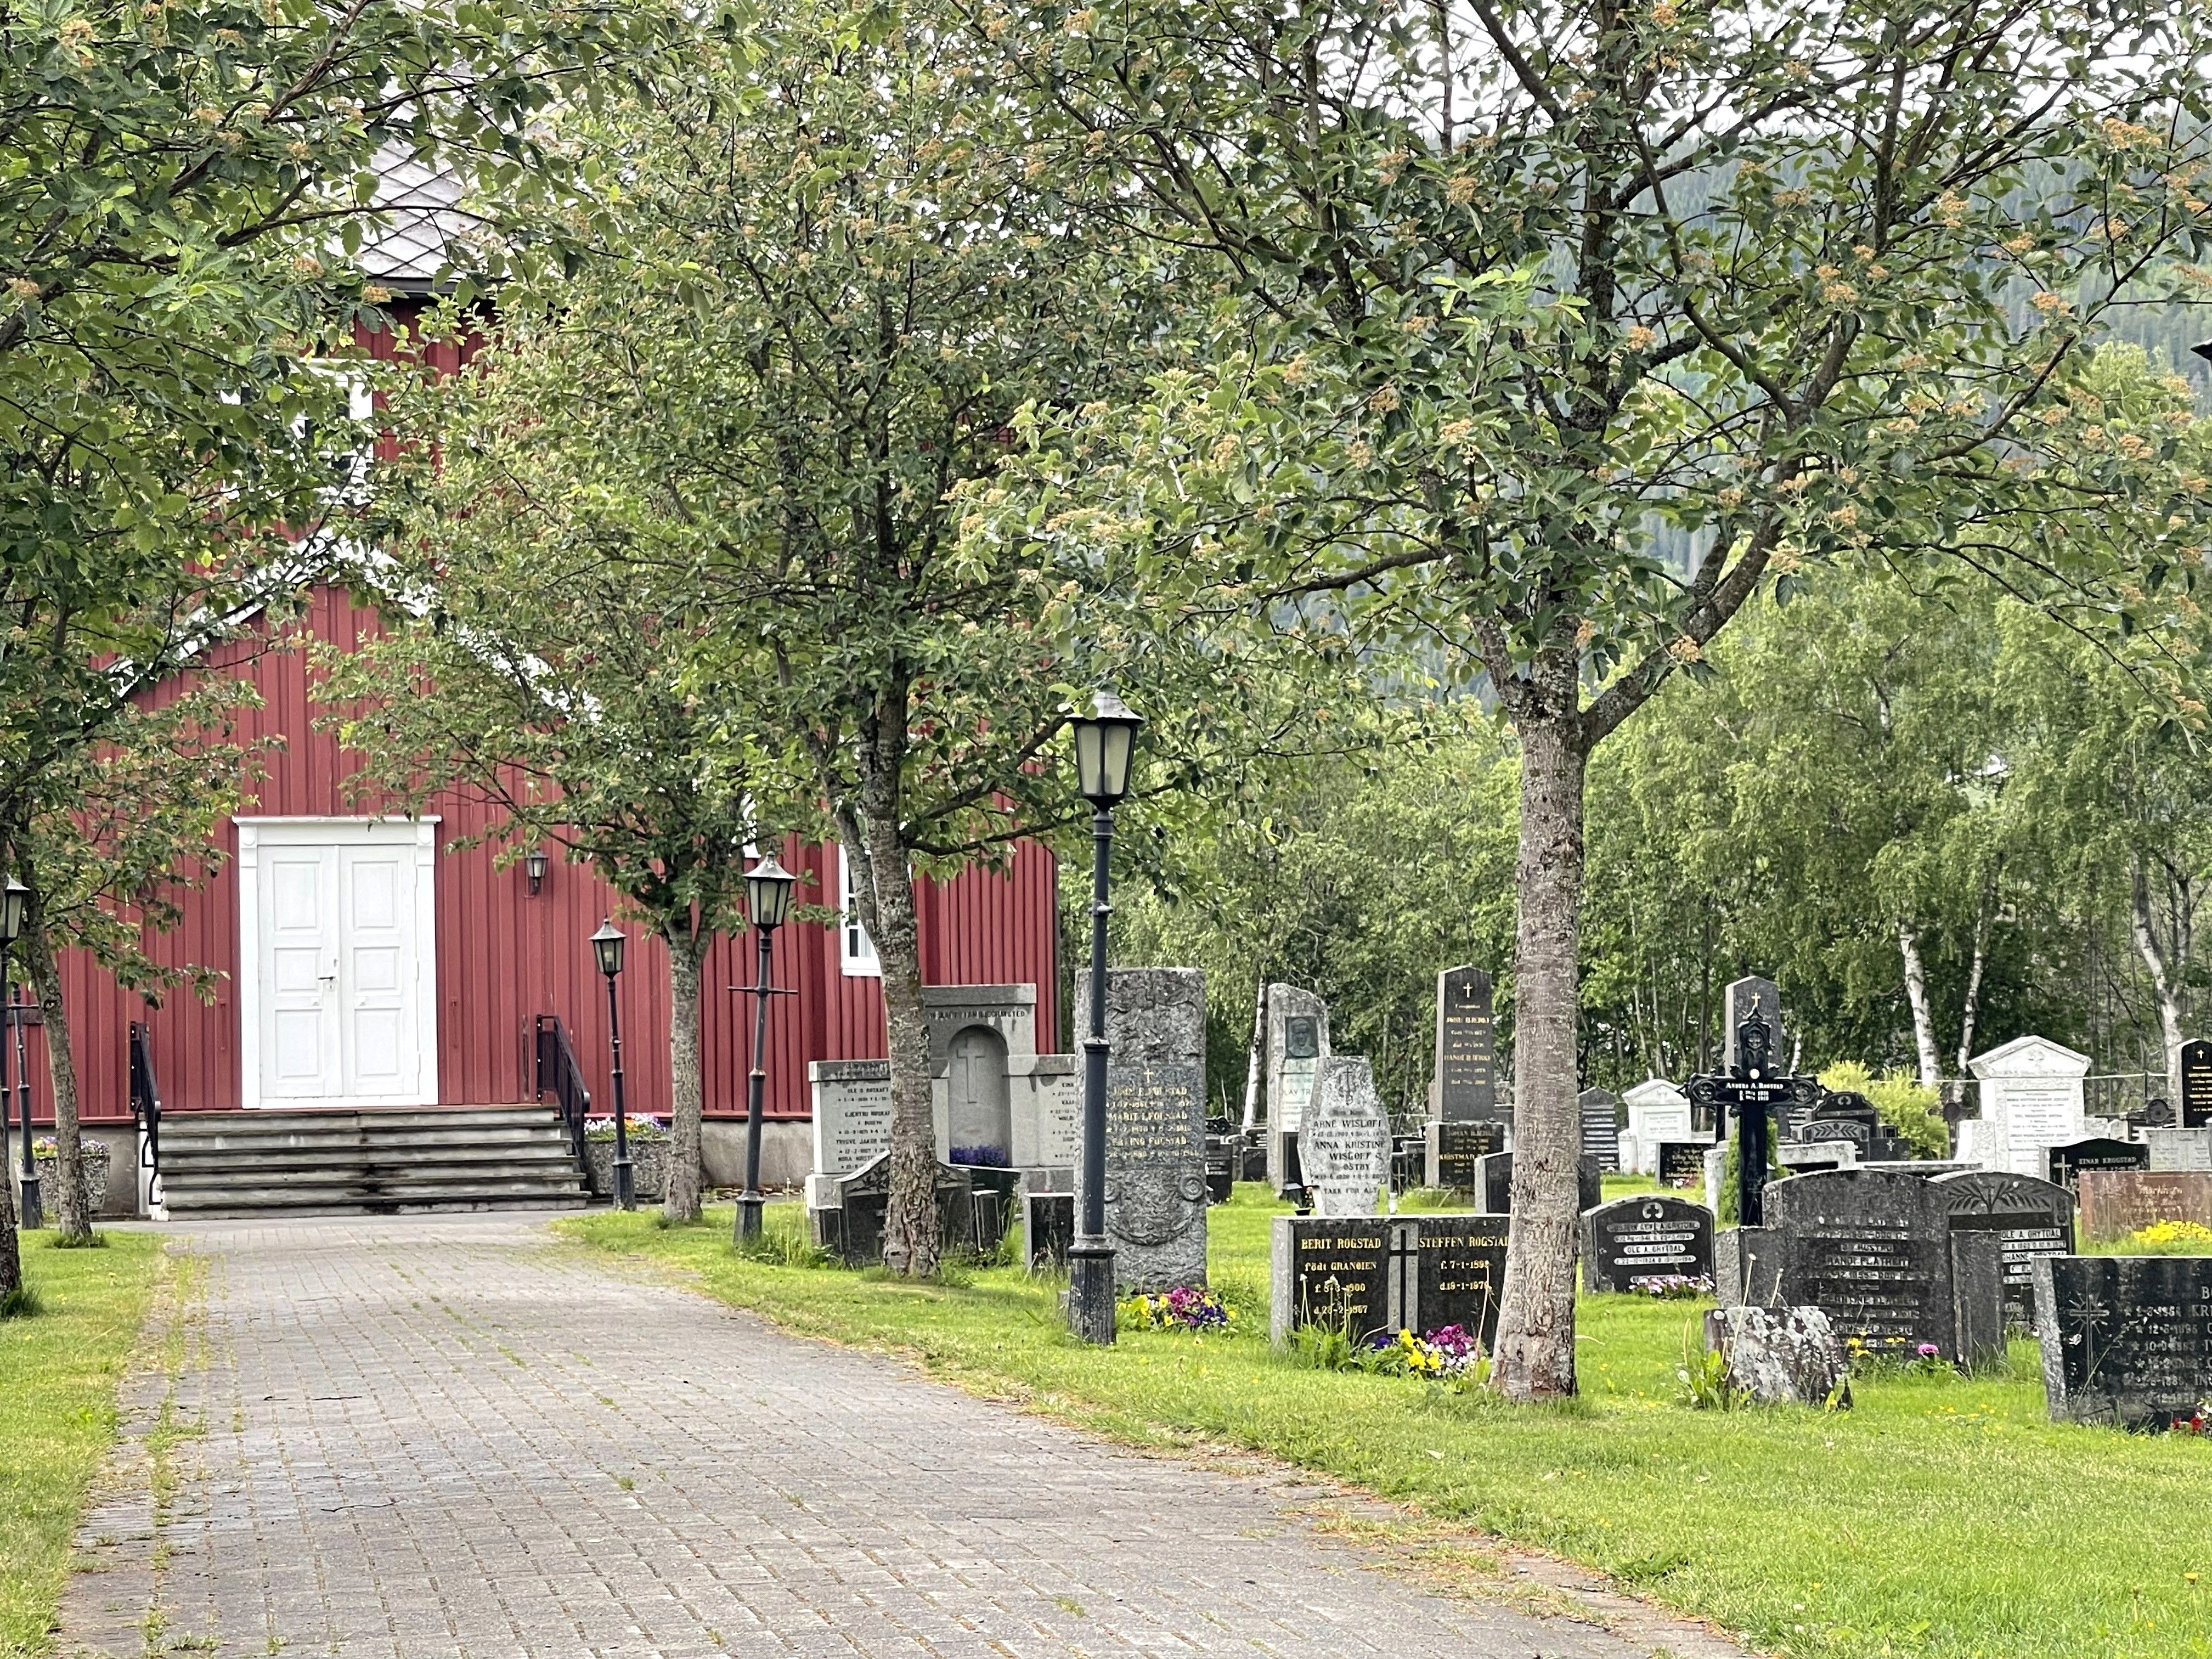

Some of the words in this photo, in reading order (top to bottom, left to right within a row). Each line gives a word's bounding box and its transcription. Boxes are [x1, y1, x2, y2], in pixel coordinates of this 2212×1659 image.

[1314, 1141, 1339, 1150] ANNA
[1301, 1238, 1332, 1250] BERIT
[1337, 1238, 1381, 1249] ROGSTAD
[1419, 1237, 1465, 1248] STEFFEN
